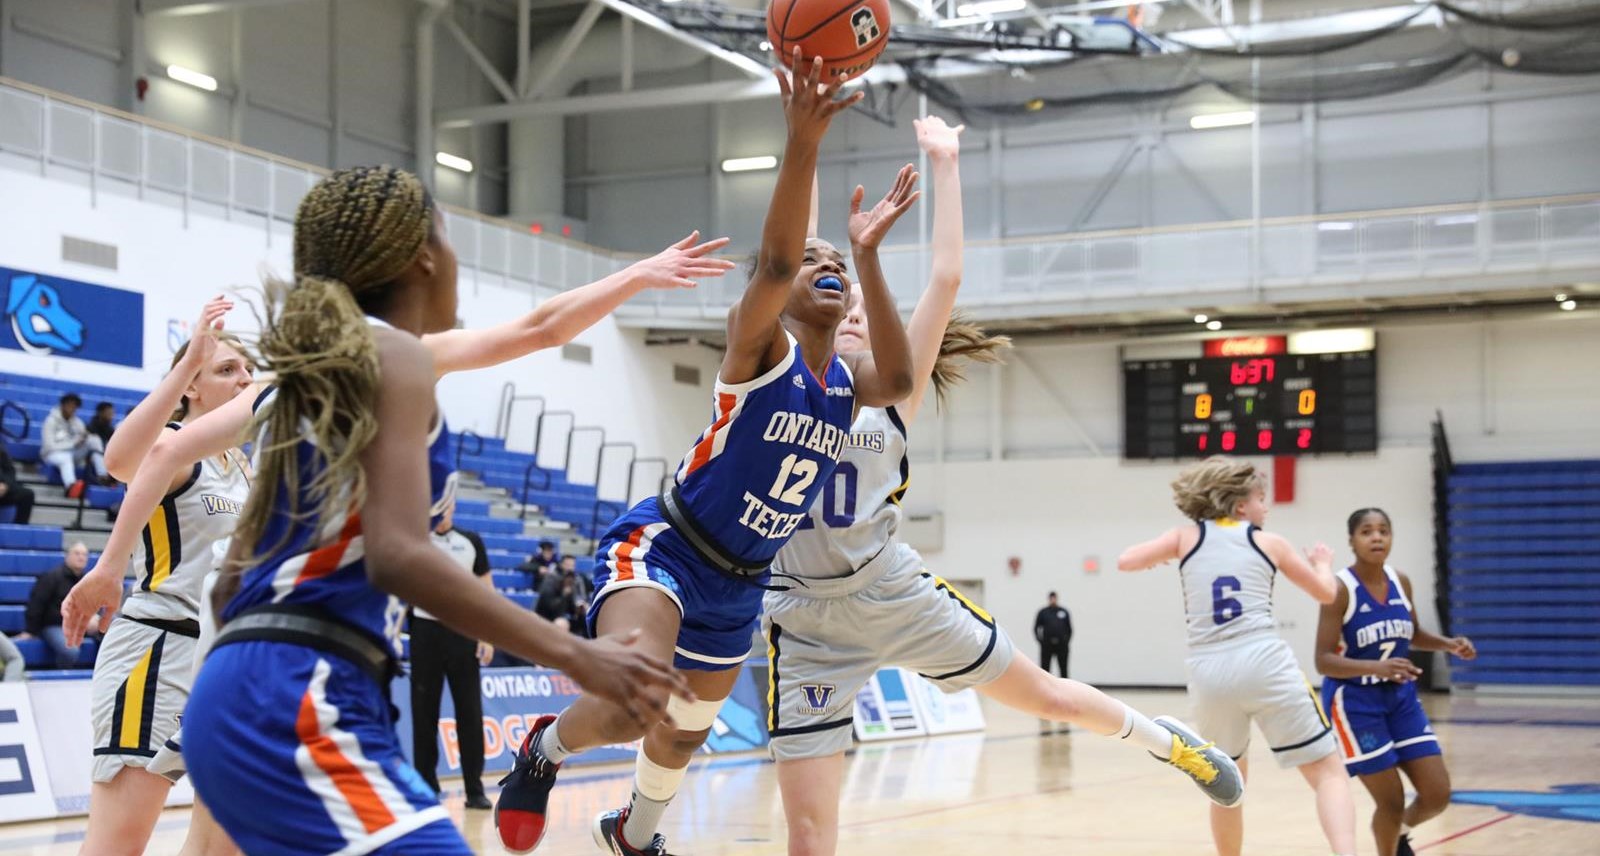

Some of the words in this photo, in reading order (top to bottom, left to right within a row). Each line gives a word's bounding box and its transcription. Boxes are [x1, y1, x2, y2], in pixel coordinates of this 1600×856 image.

[1194, 393, 1212, 419] 8
[1298, 389, 1316, 415] 0
[768, 453, 819, 507] 12
[1211, 575, 1242, 625] 6
[1379, 641, 1397, 661] 7
[481, 675, 553, 698] ONTARIO
[800, 684, 836, 709] V
